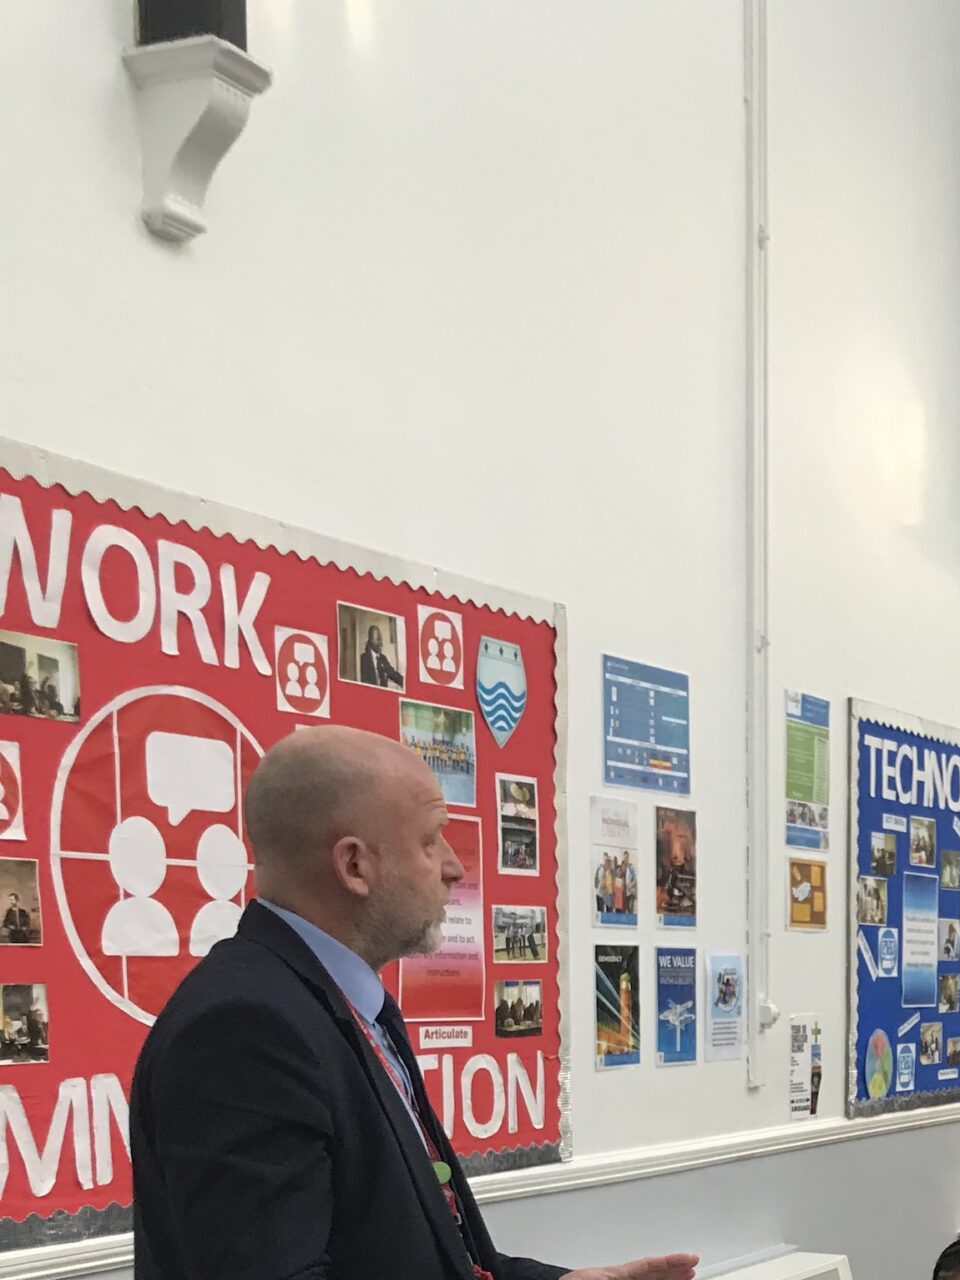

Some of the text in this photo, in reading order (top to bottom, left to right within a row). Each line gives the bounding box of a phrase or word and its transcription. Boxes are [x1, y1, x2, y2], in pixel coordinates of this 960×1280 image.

[658, 955, 695, 968] WE VALUE
[424, 1029, 469, 1040] Articulate
